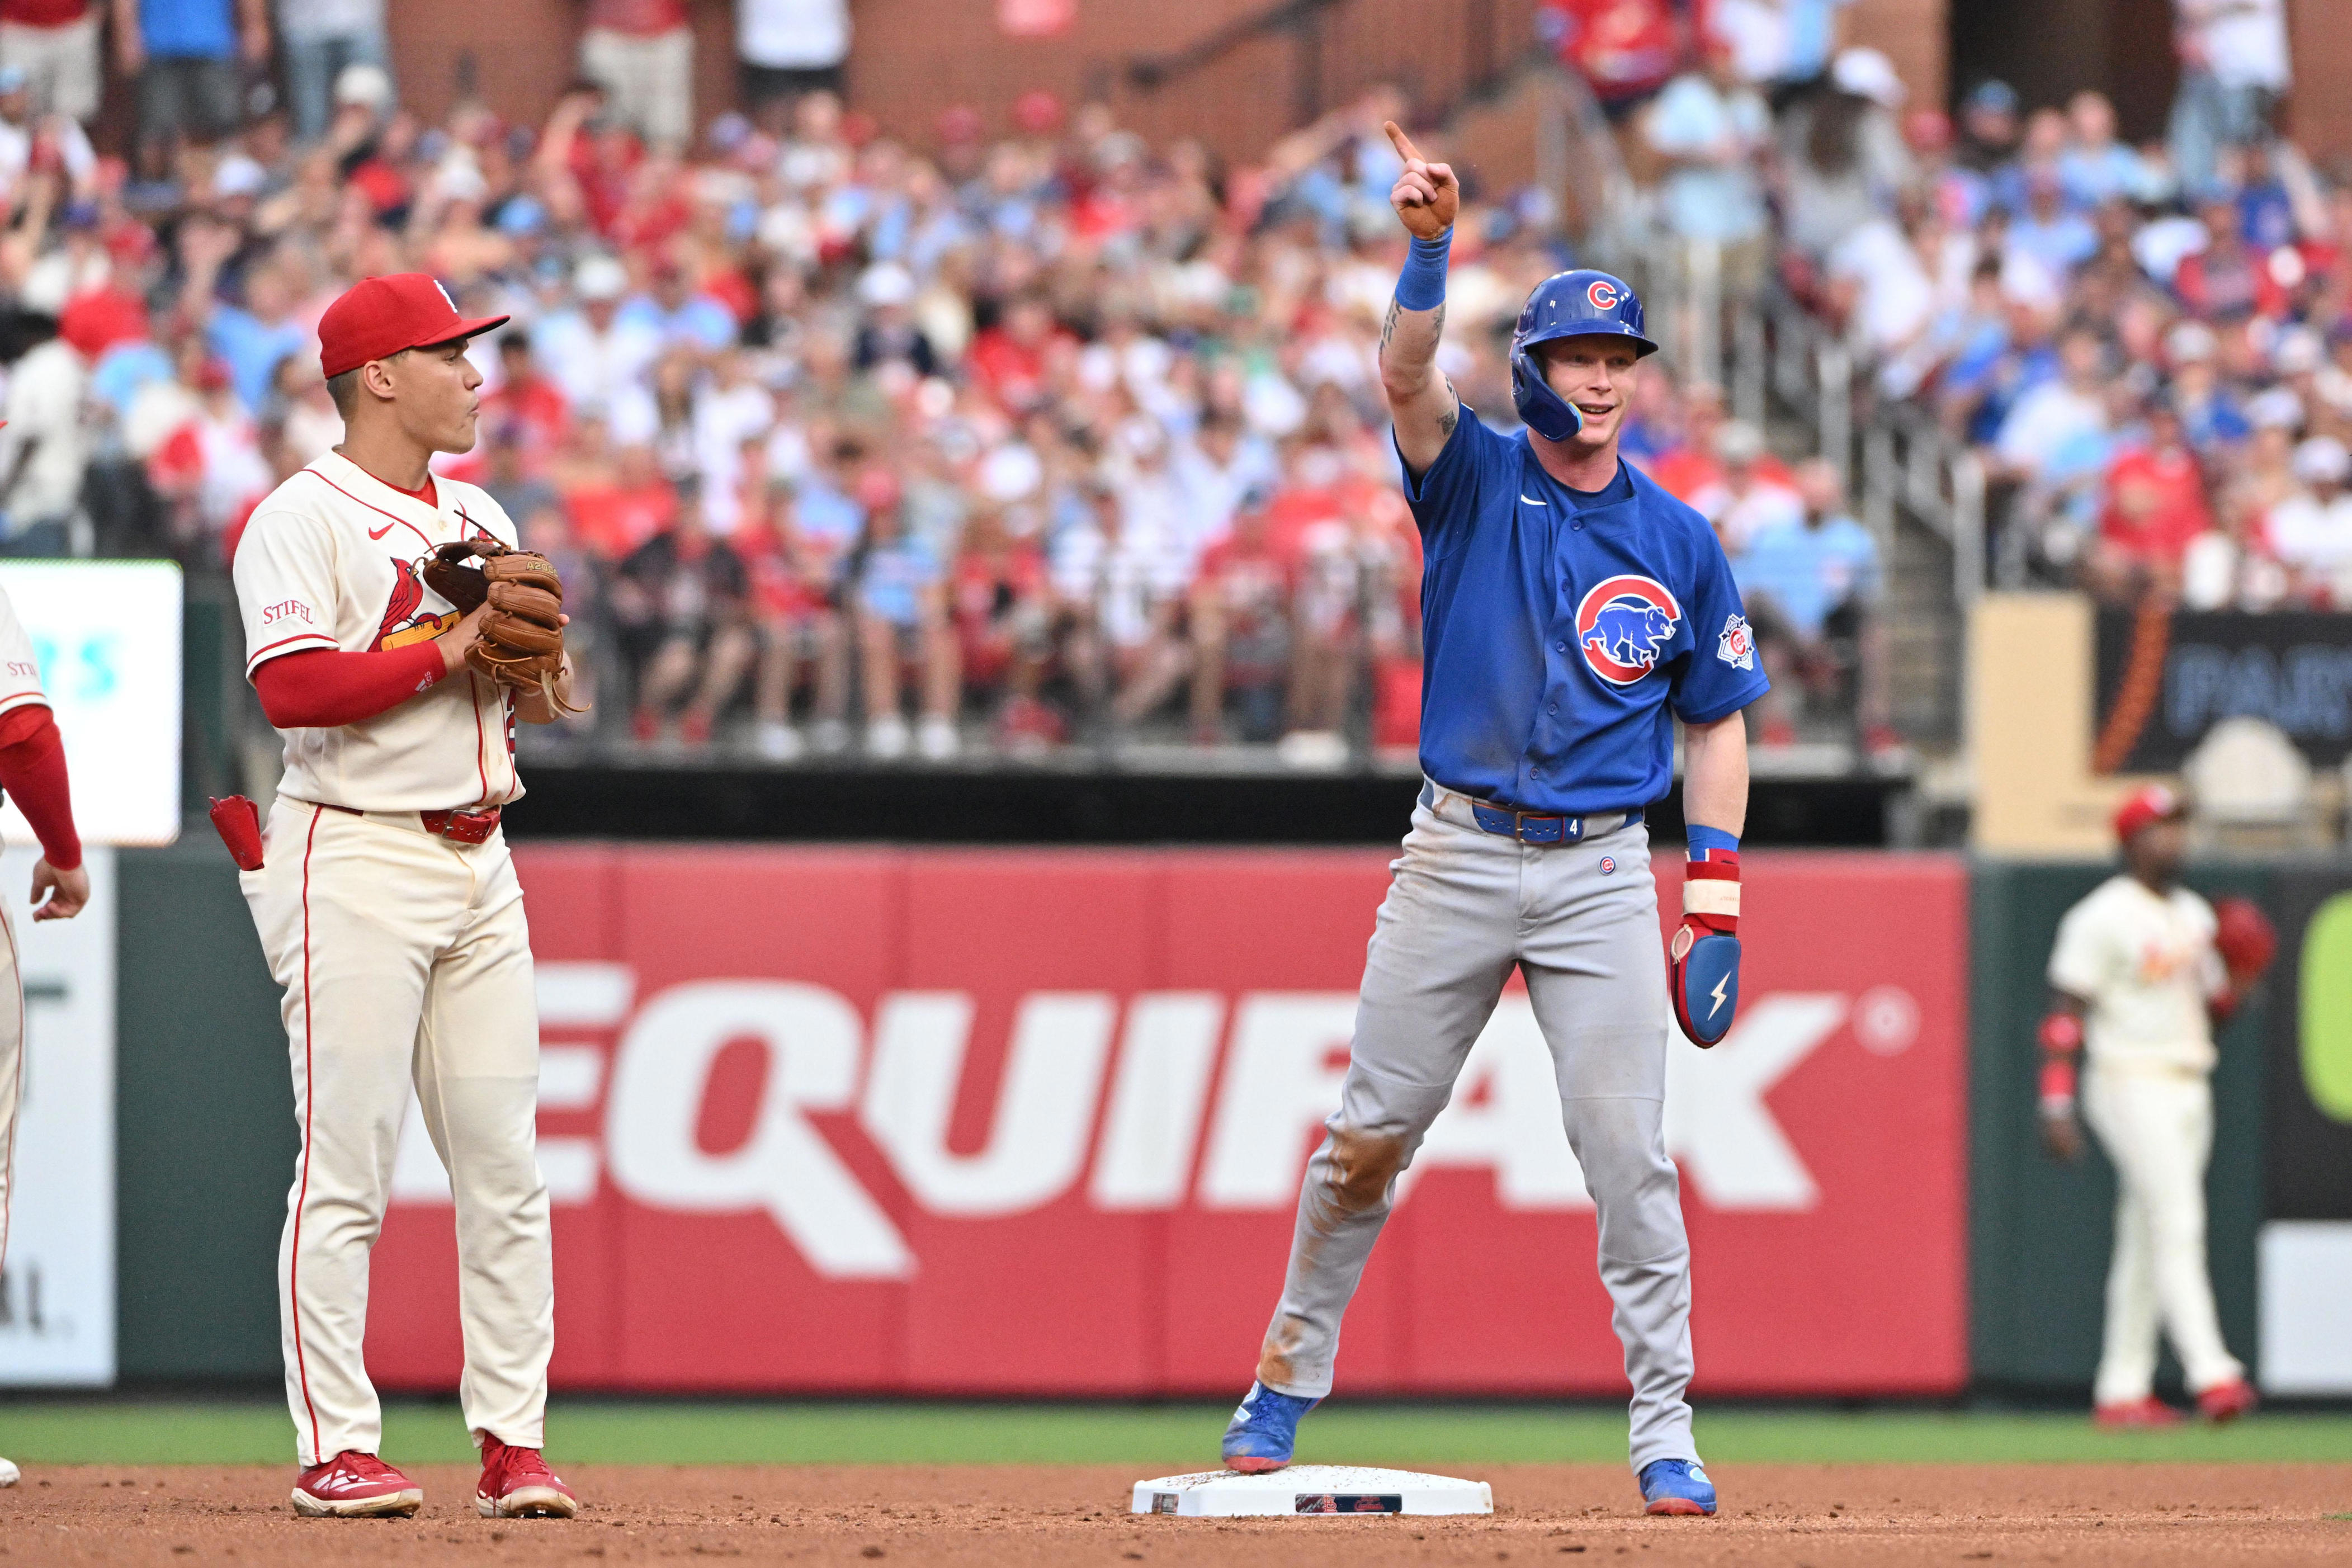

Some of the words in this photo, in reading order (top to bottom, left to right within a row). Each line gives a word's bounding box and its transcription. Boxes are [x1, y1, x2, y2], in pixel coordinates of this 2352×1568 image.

[1587, 281, 1618, 310] C
[263, 599, 313, 625] STIFEL
[1570, 819, 1578, 835] 4
